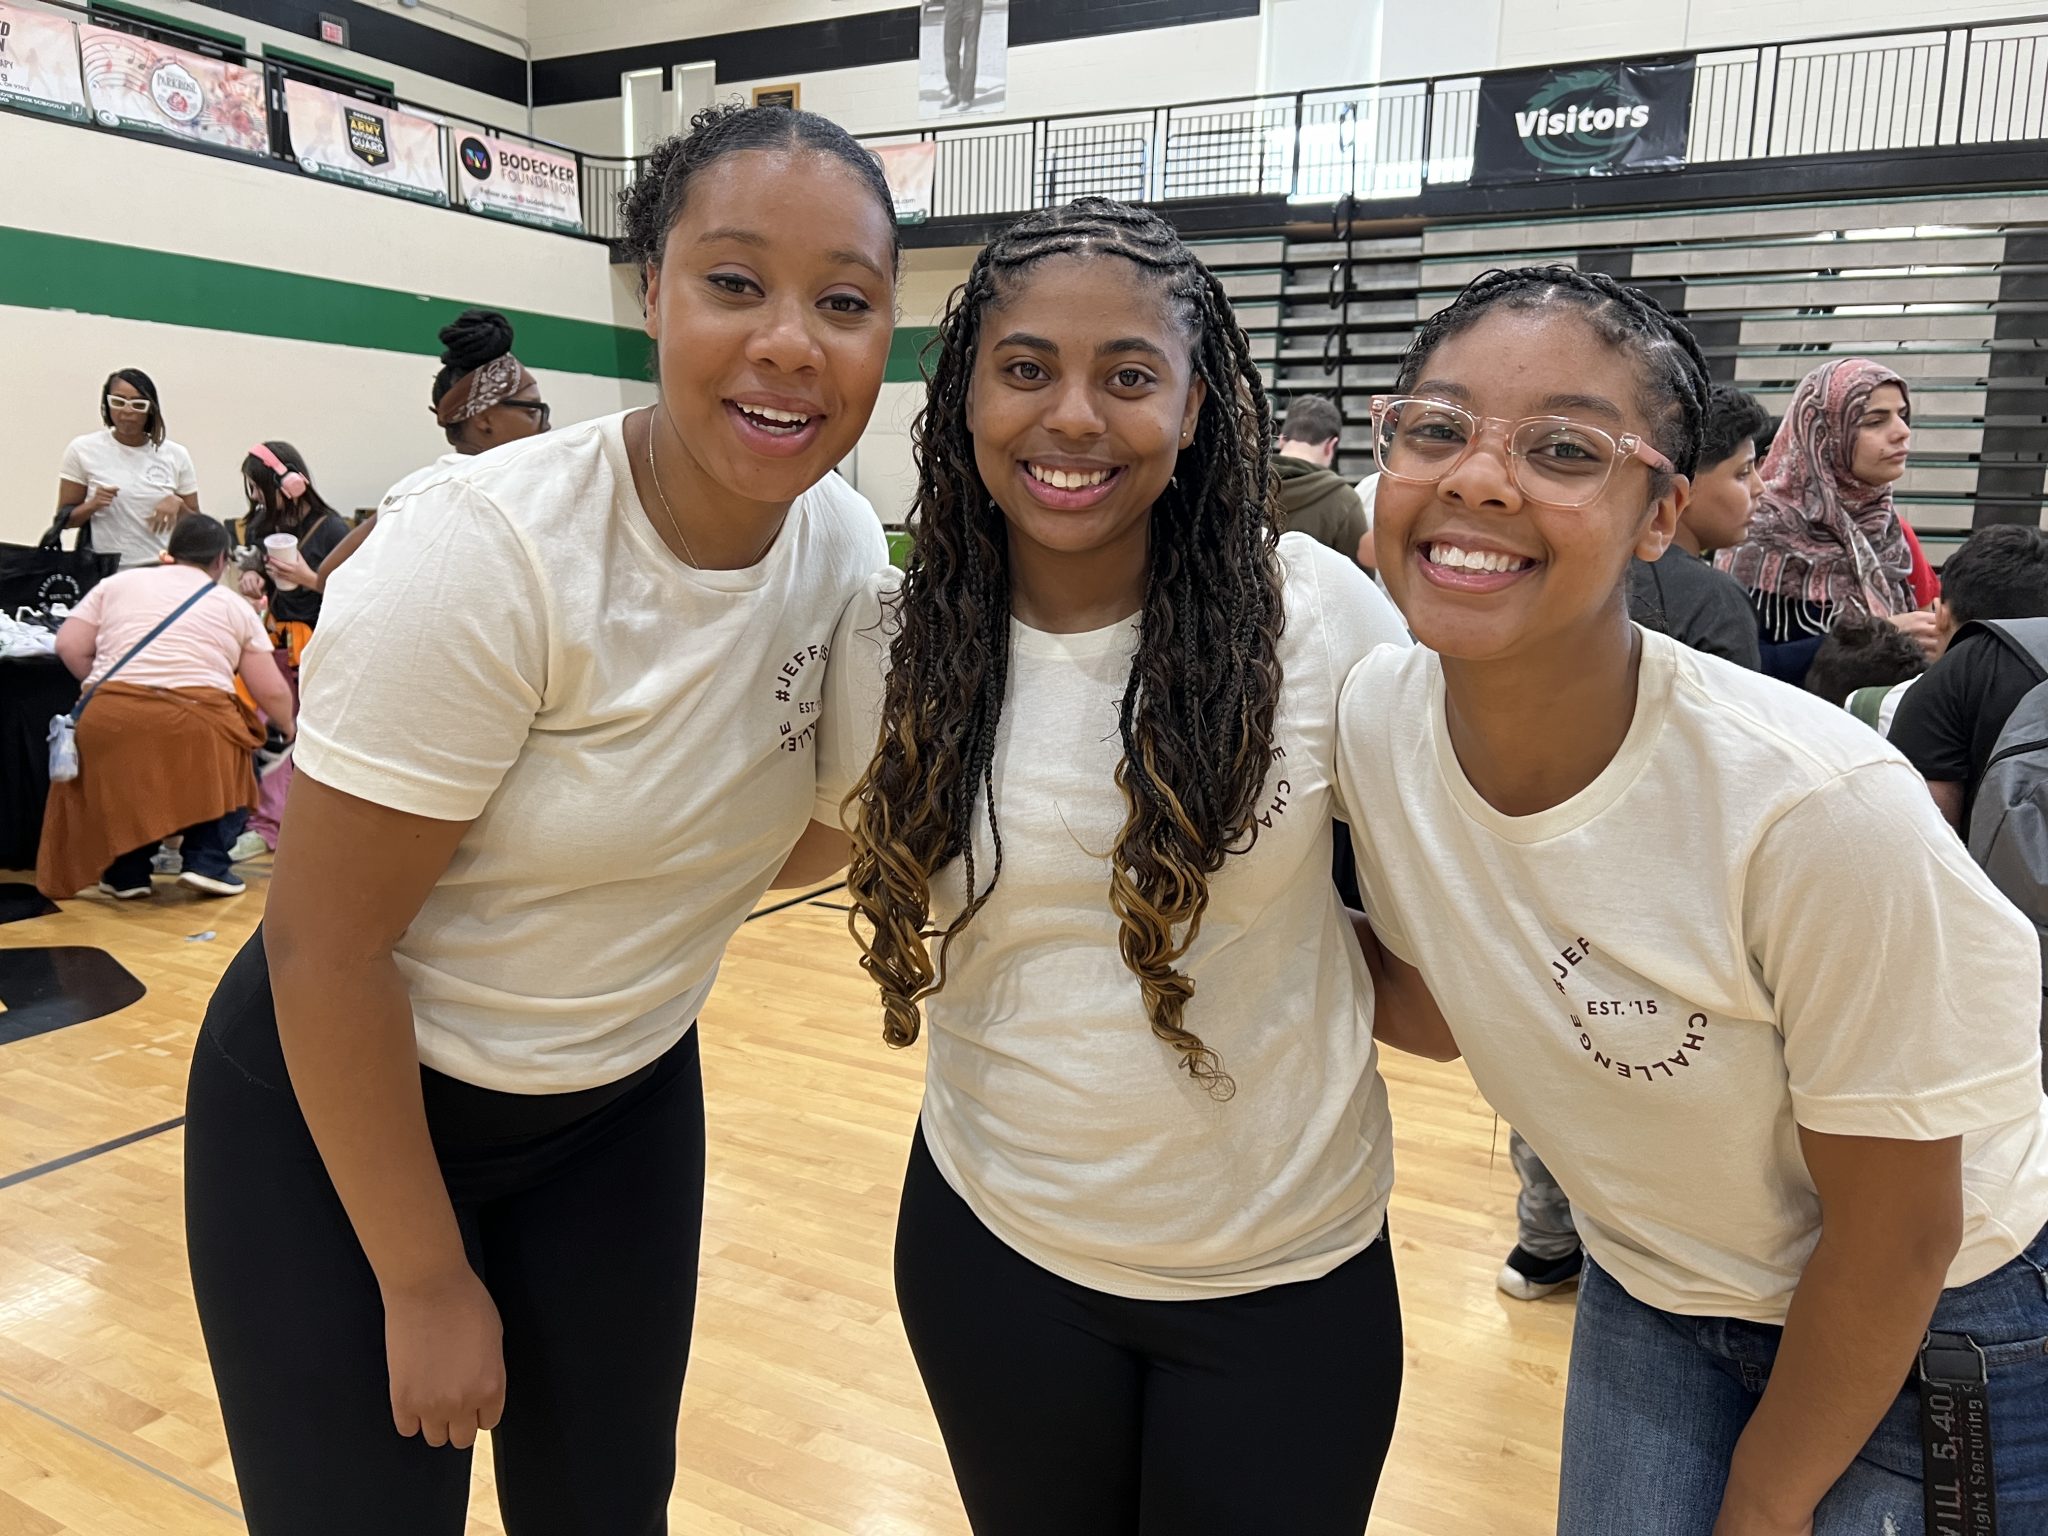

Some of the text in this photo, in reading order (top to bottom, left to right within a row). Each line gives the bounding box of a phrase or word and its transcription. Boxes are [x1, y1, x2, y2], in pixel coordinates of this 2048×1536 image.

[0, 20, 11, 37] D
[350, 119, 381, 136] ARMY
[1514, 104, 1650, 138] Visitors
[351, 136, 385, 154] GUARD
[499, 151, 575, 184] BODECKER
[500, 168, 576, 197] FOUNDATION
[798, 701, 816, 714] EST.
[1257, 779, 1291, 829] CHA
[1586, 1001, 1625, 1016] EST.
[1569, 1012, 1708, 1082] CHALLENGE
[1965, 1399, 1988, 1486] Securing
